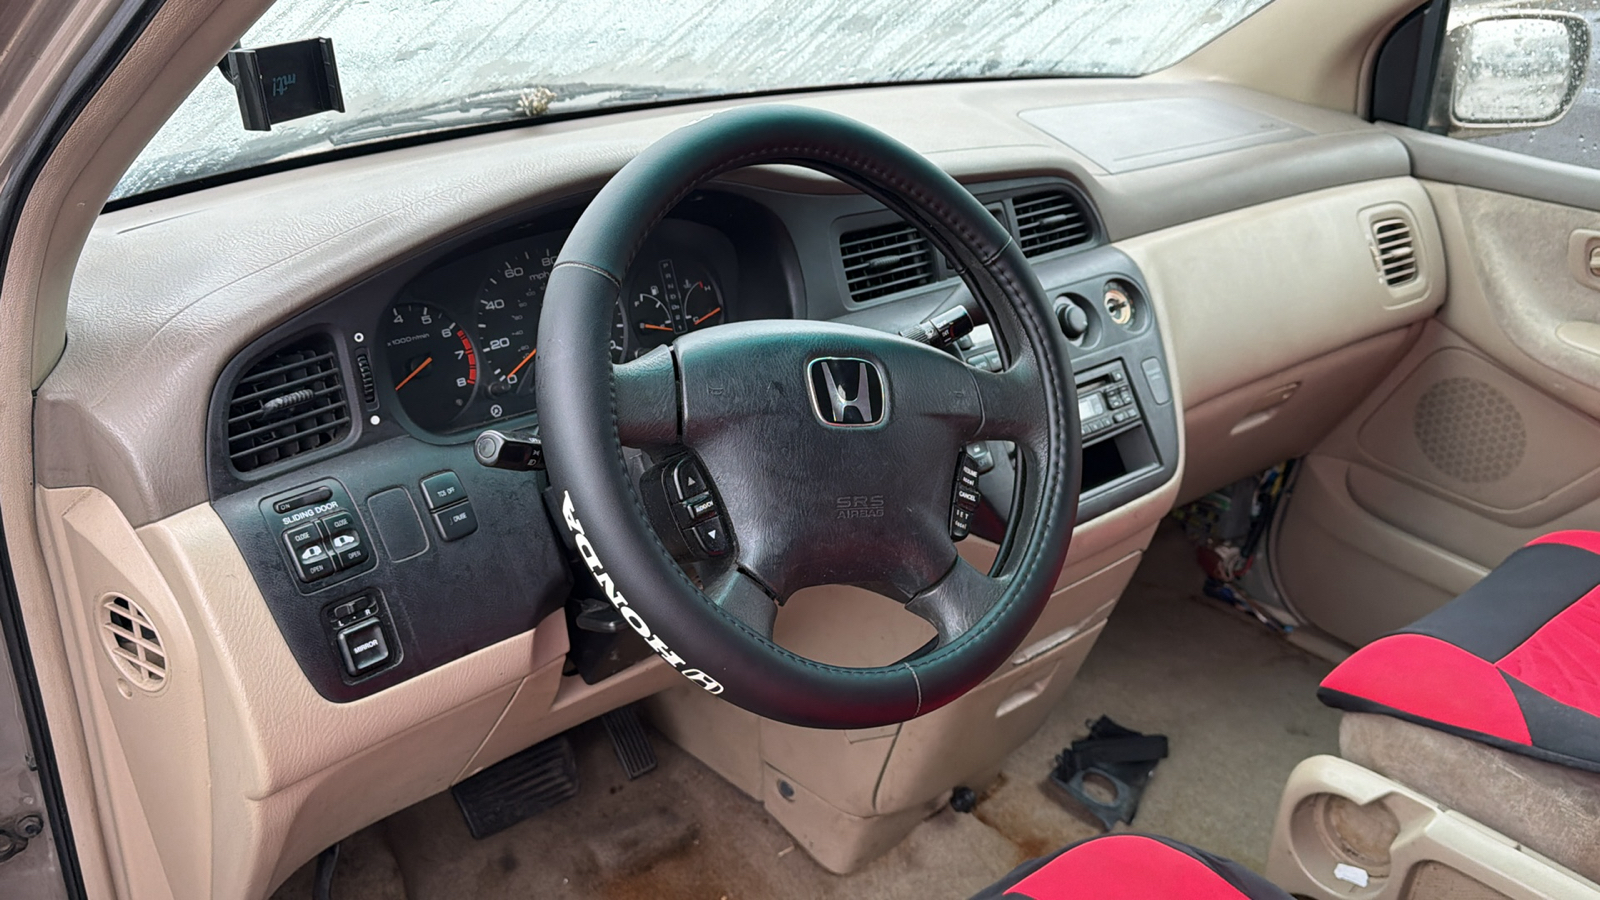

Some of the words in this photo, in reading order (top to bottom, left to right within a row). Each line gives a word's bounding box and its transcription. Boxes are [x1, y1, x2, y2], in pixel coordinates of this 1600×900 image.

[504, 267, 524, 278] 60
[485, 299, 505, 311] 40
[393, 314, 404, 323] 4
[421, 314, 432, 325] 5
[441, 328, 452, 338] 6
[490, 337, 510, 350] 20
[454, 350, 465, 360] 7
[456, 377, 467, 387] 8
[507, 374, 518, 384] 0
[959, 490, 976, 502] CANCEL
[836, 495, 884, 508] SRS
[280, 503, 291, 511] ON
[282, 509, 315, 525] SLIDING
[314, 501, 339, 514] DOOR
[836, 508, 884, 519] AIRBAG
[334, 518, 349, 528] CLOSE
[294, 532, 310, 542] CLOSE
[347, 550, 362, 560] OPEN
[309, 564, 324, 574] OPEN
[562, 490, 687, 668] HONDA
[364, 608, 371, 616] R
[353, 638, 379, 654] MIRROR
